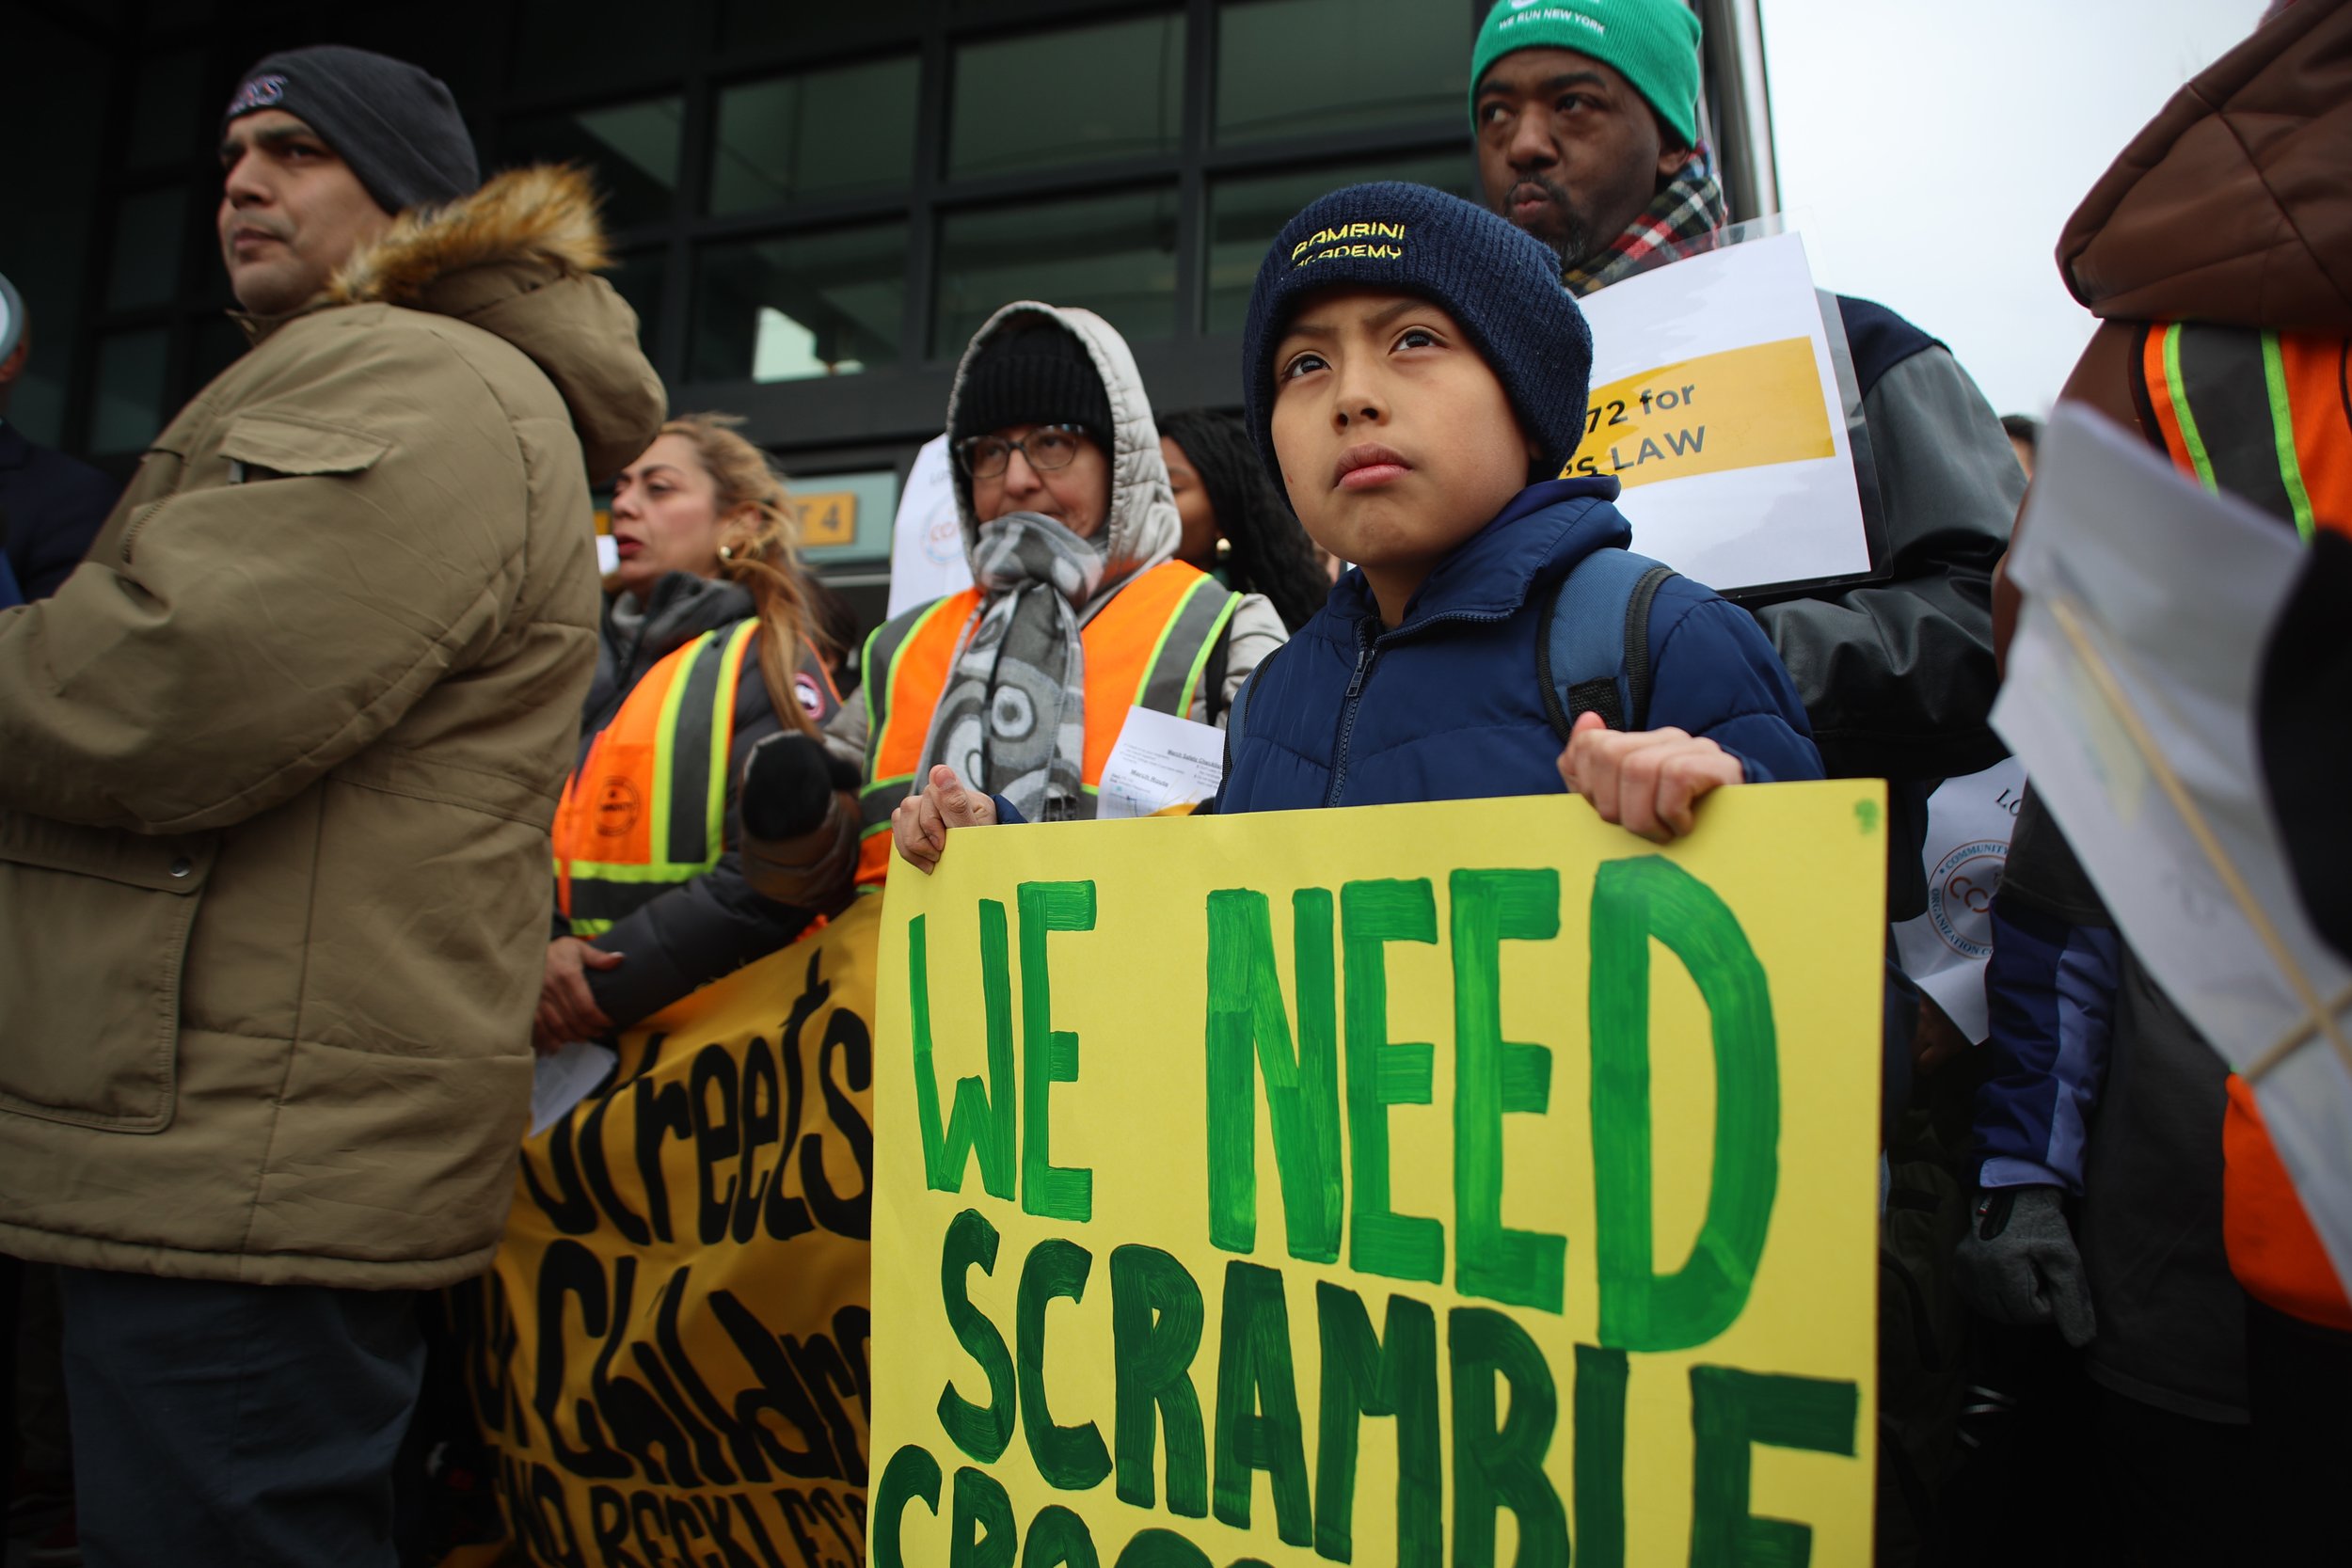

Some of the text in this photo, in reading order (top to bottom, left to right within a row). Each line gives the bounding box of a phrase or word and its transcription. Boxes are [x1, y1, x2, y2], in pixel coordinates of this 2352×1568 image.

[1499, 8, 1606, 36] WE RUN NEW YORK
[1639, 383, 1695, 415] for
[1610, 425, 1706, 471] LAW
[1931, 887, 1981, 955] ORGANIZATION
[908, 853, 1781, 1353] WE NEED
[533, 1239, 872, 1488] Childr
